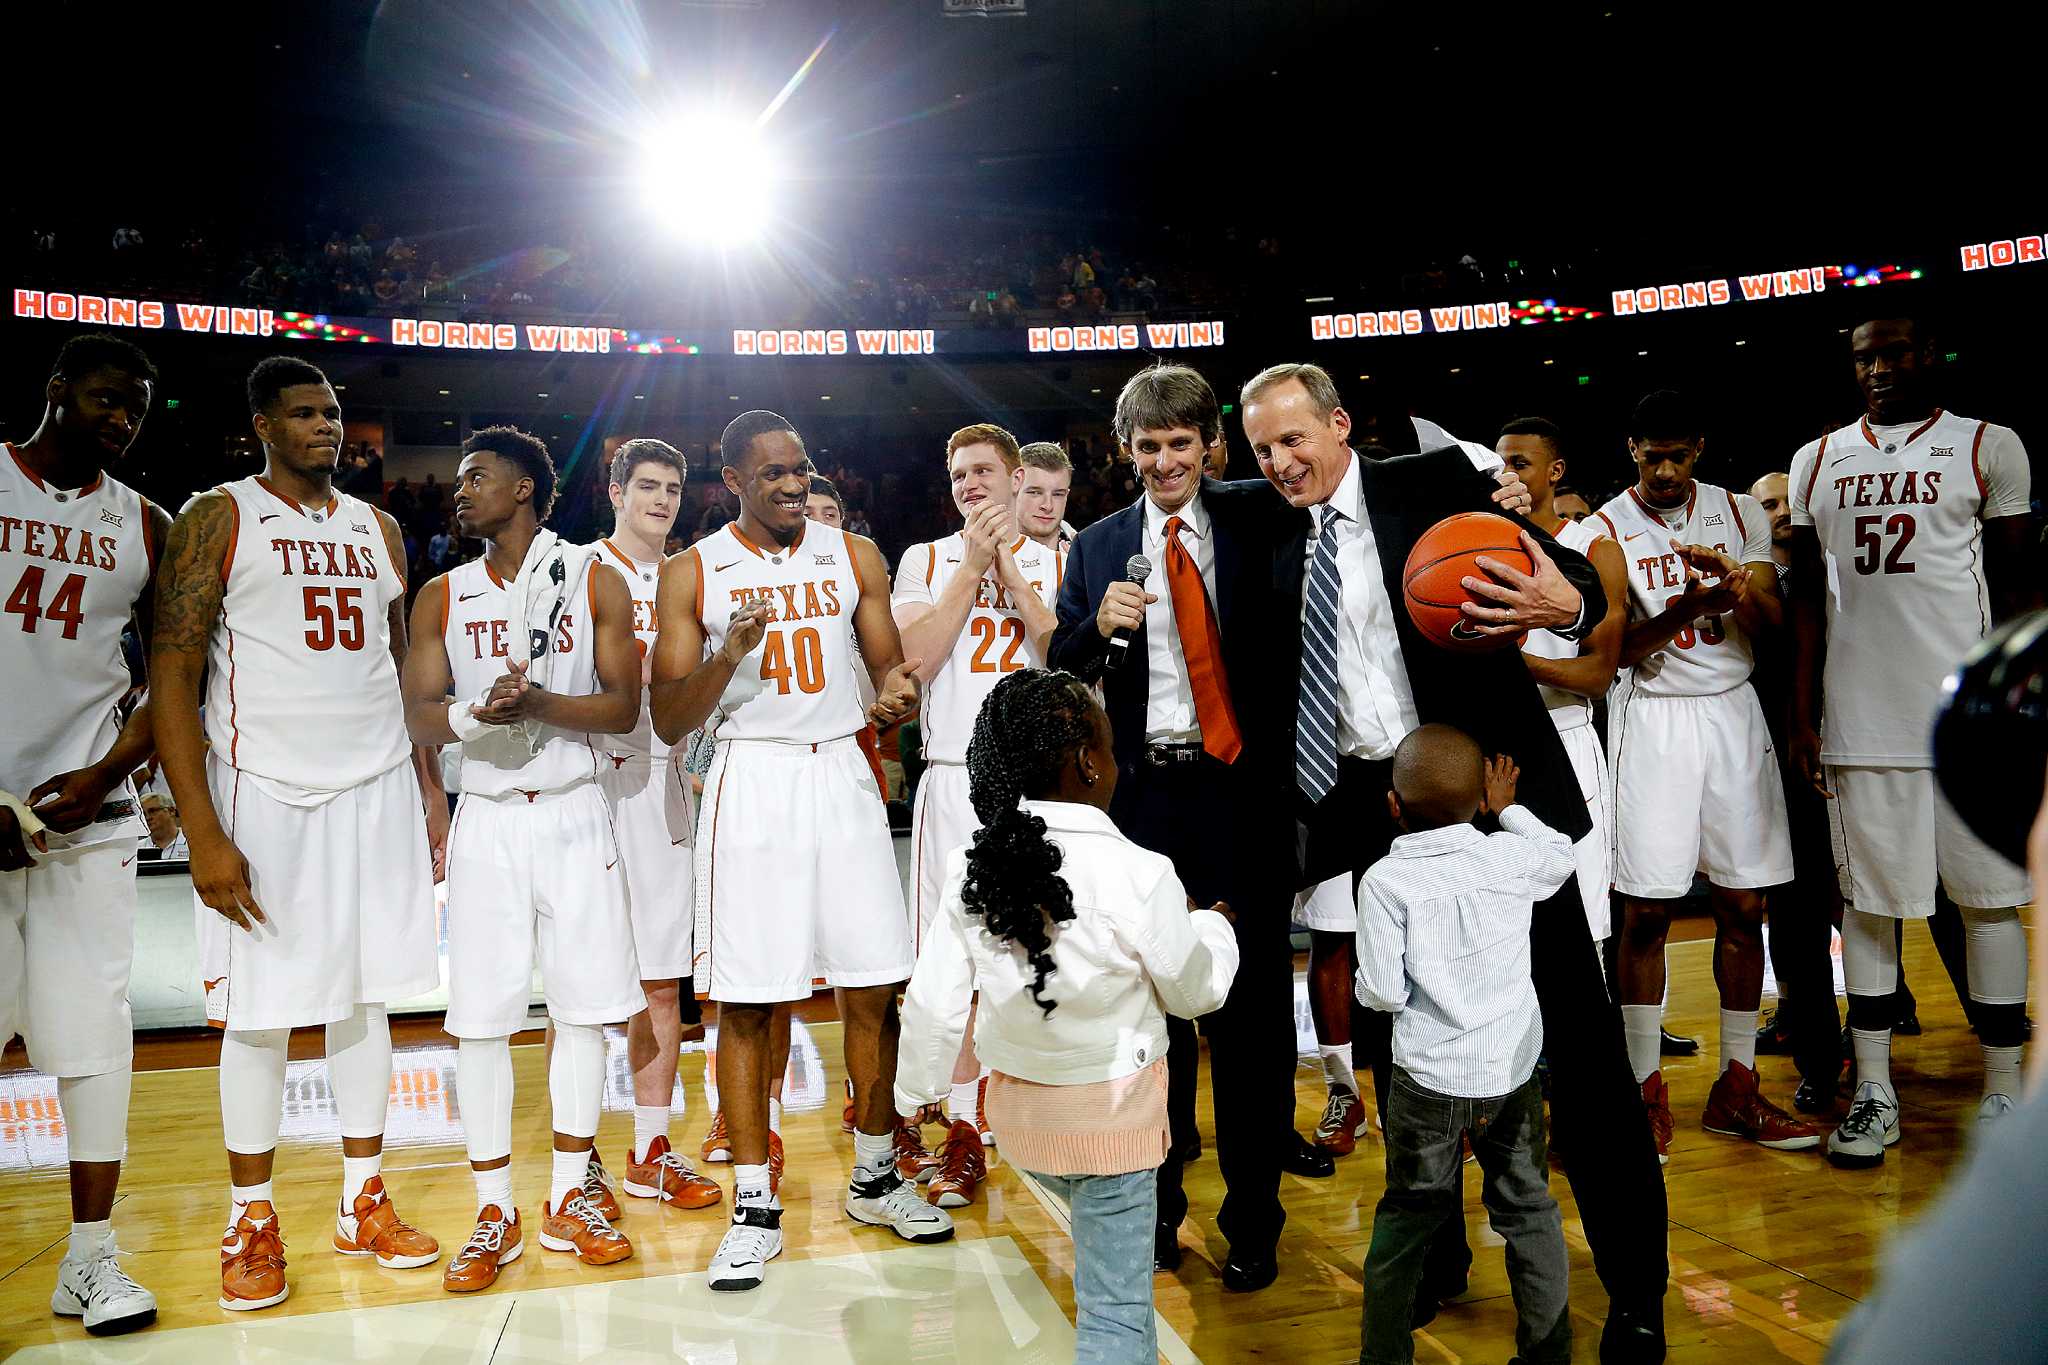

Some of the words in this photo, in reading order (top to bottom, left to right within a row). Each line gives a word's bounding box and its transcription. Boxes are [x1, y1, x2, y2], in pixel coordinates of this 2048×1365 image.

[1960, 233, 2048, 271] HOR
[13, 289, 164, 328] HORNS
[176, 304, 274, 338] WIN!
[1612, 277, 1728, 316] HORNS
[1738, 266, 1826, 302] WIN!
[391, 318, 517, 351] HORNS
[528, 326, 611, 354] WIN!
[733, 329, 848, 355] HORNS
[856, 329, 935, 355] WIN!
[1028, 325, 1140, 353] HORNS
[1146, 321, 1225, 349] WIN!
[1311, 308, 1423, 340] HORNS
[1430, 303, 1510, 332] WIN!
[1834, 471, 1941, 509] TEXAS
[0, 515, 117, 571] TEXAS
[271, 538, 378, 580] TEXAS
[1853, 513, 1917, 576] 52
[5, 564, 87, 640] 44
[302, 586, 365, 651] 55
[729, 580, 841, 623] TEXAS
[465, 613, 574, 660] TES
[970, 616, 1026, 673] 22
[760, 627, 826, 695] 40
